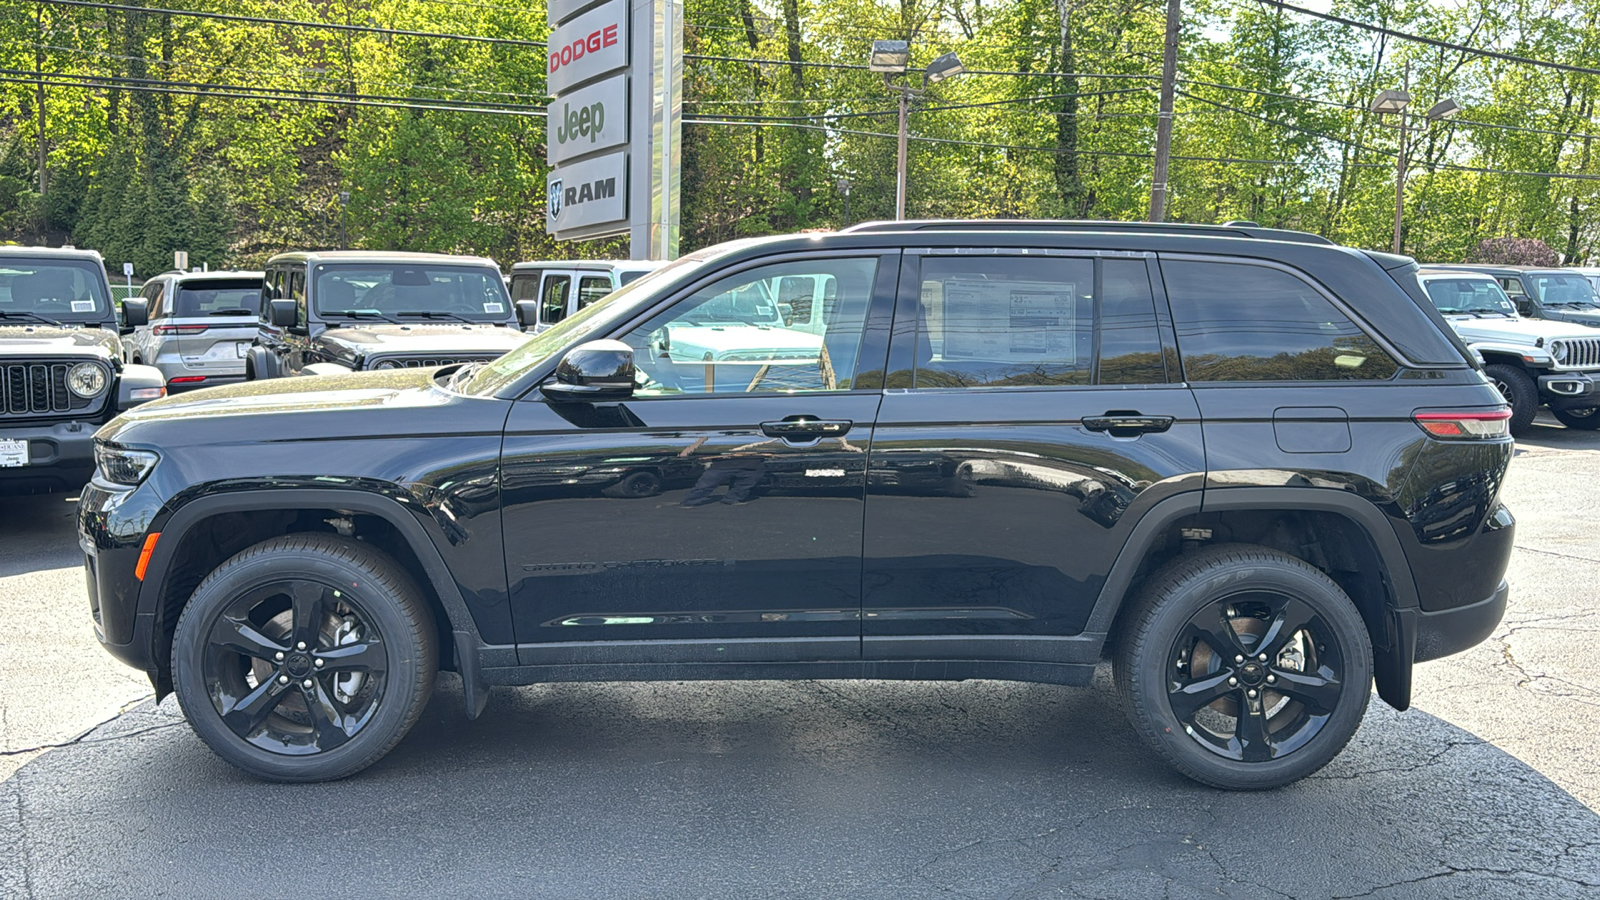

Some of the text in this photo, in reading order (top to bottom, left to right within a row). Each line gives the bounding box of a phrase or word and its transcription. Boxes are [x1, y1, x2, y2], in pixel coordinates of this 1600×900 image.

[550, 24, 617, 73] DODGE
[557, 101, 605, 144] Jeep
[564, 177, 616, 207] RAM
[522, 562, 596, 571] GRAND
